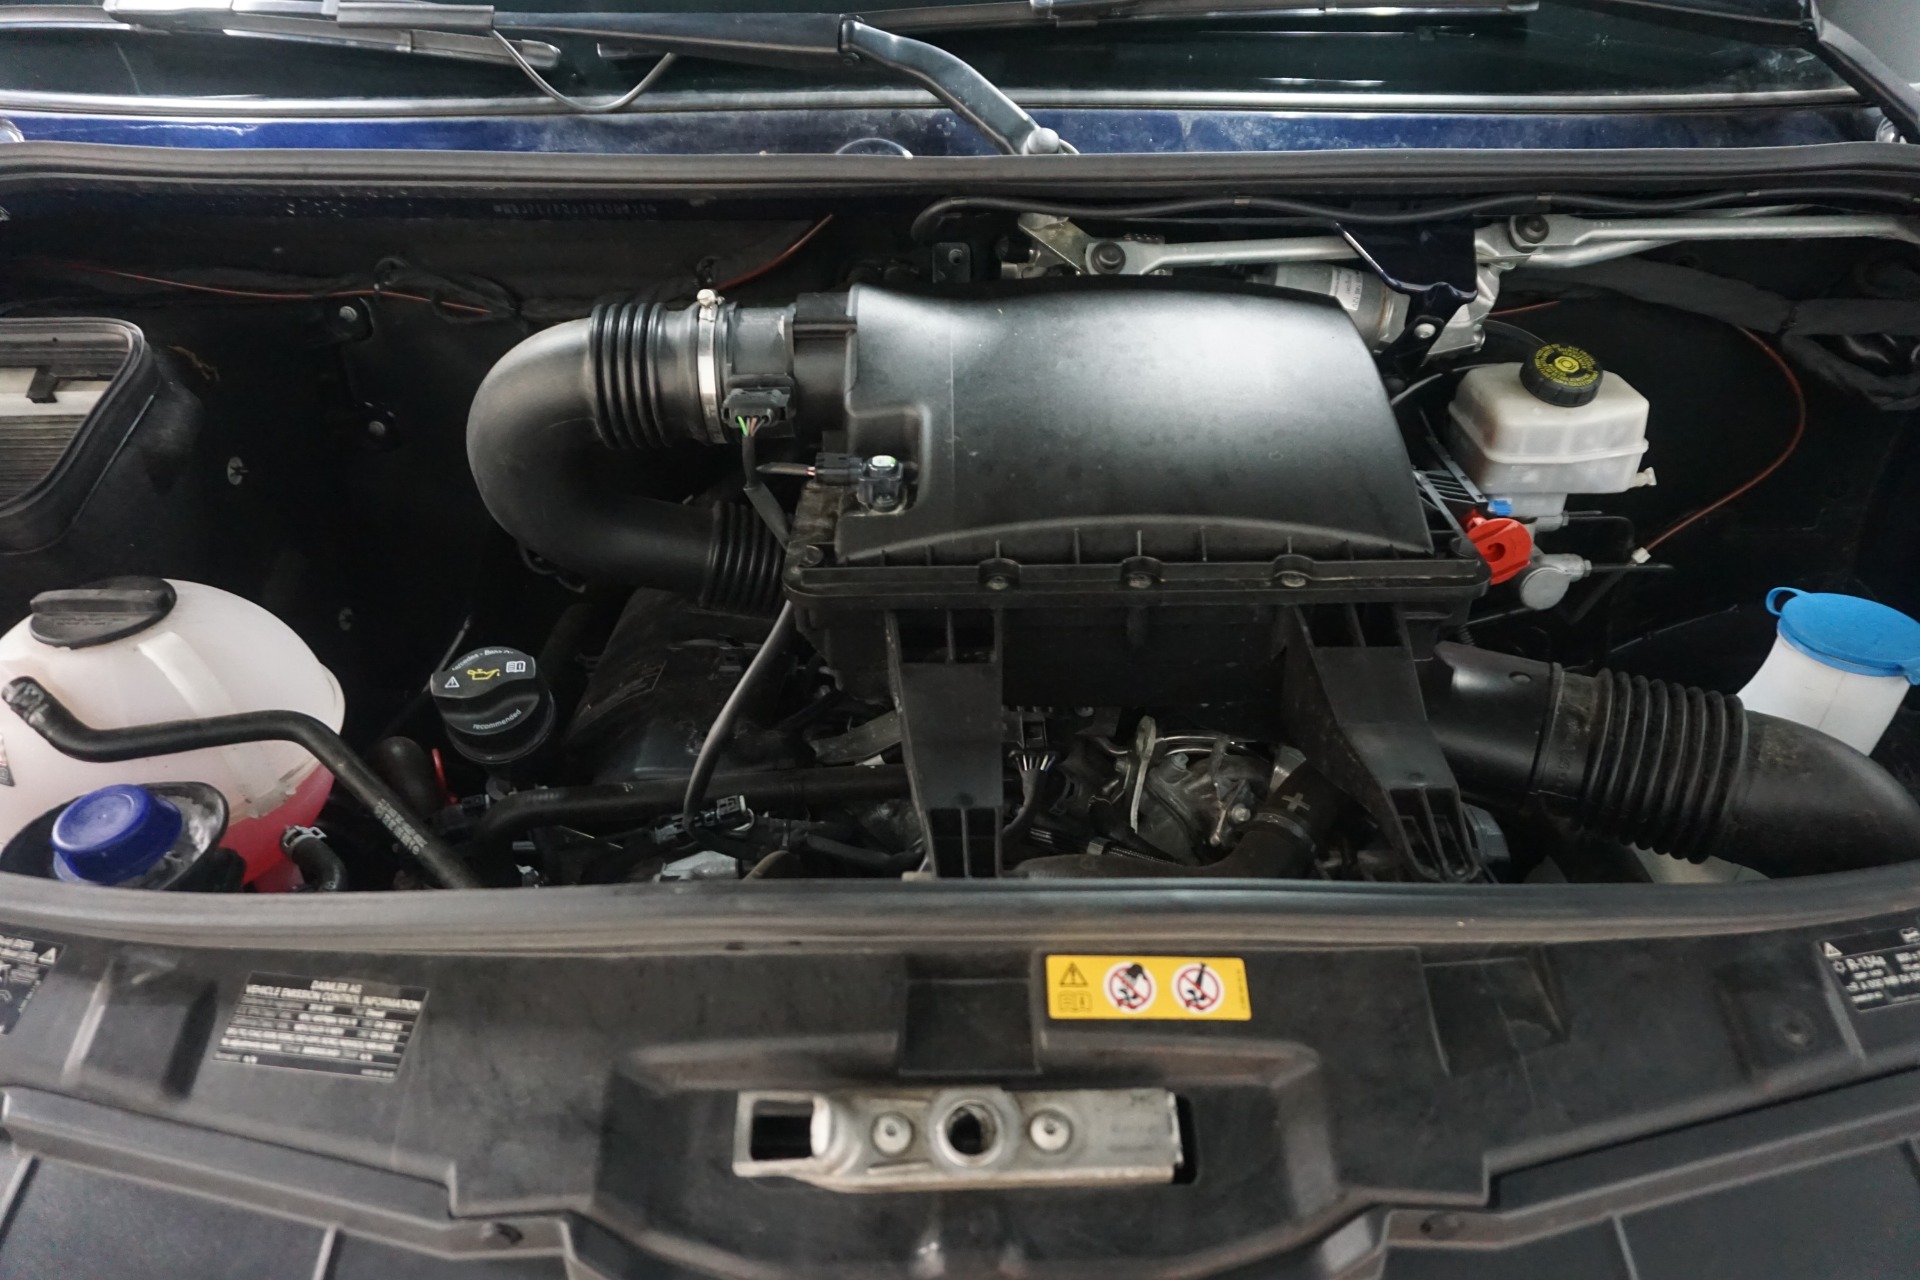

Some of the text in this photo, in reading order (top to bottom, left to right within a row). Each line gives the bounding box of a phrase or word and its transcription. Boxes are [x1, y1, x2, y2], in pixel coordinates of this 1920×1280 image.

[472, 708, 522, 730] recommended
[245, 984, 280, 998] VEHICLE
[280, 988, 321, 1001] EMISSION
[321, 992, 360, 1005] CONTROL
[361, 996, 422, 1011] INFORMATION
[310, 979, 363, 995] DAIMLER AG
